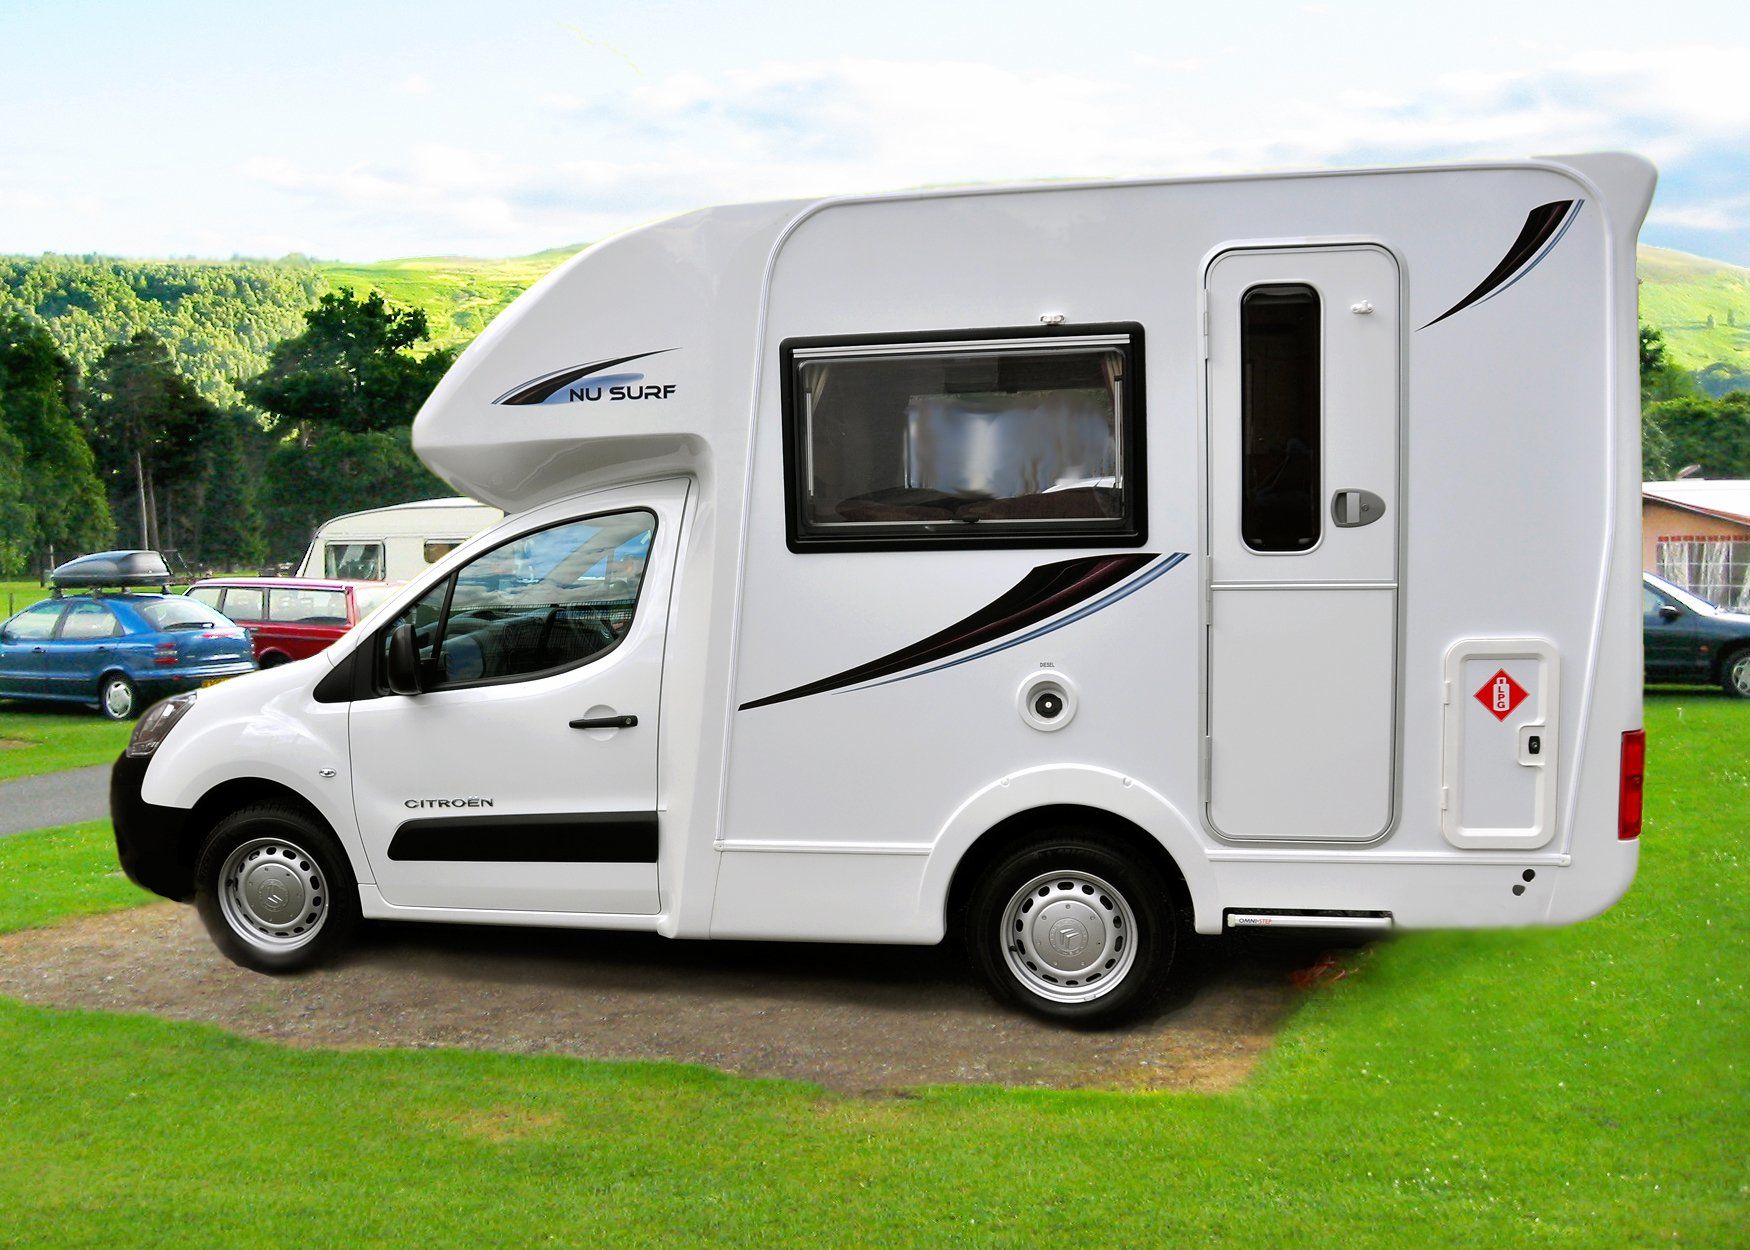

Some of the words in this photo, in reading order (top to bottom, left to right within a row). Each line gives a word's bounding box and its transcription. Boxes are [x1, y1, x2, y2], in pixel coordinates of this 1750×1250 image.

[569, 387, 602, 402] NU
[609, 384, 677, 400] SURF
[1497, 685, 1506, 709] LPG
